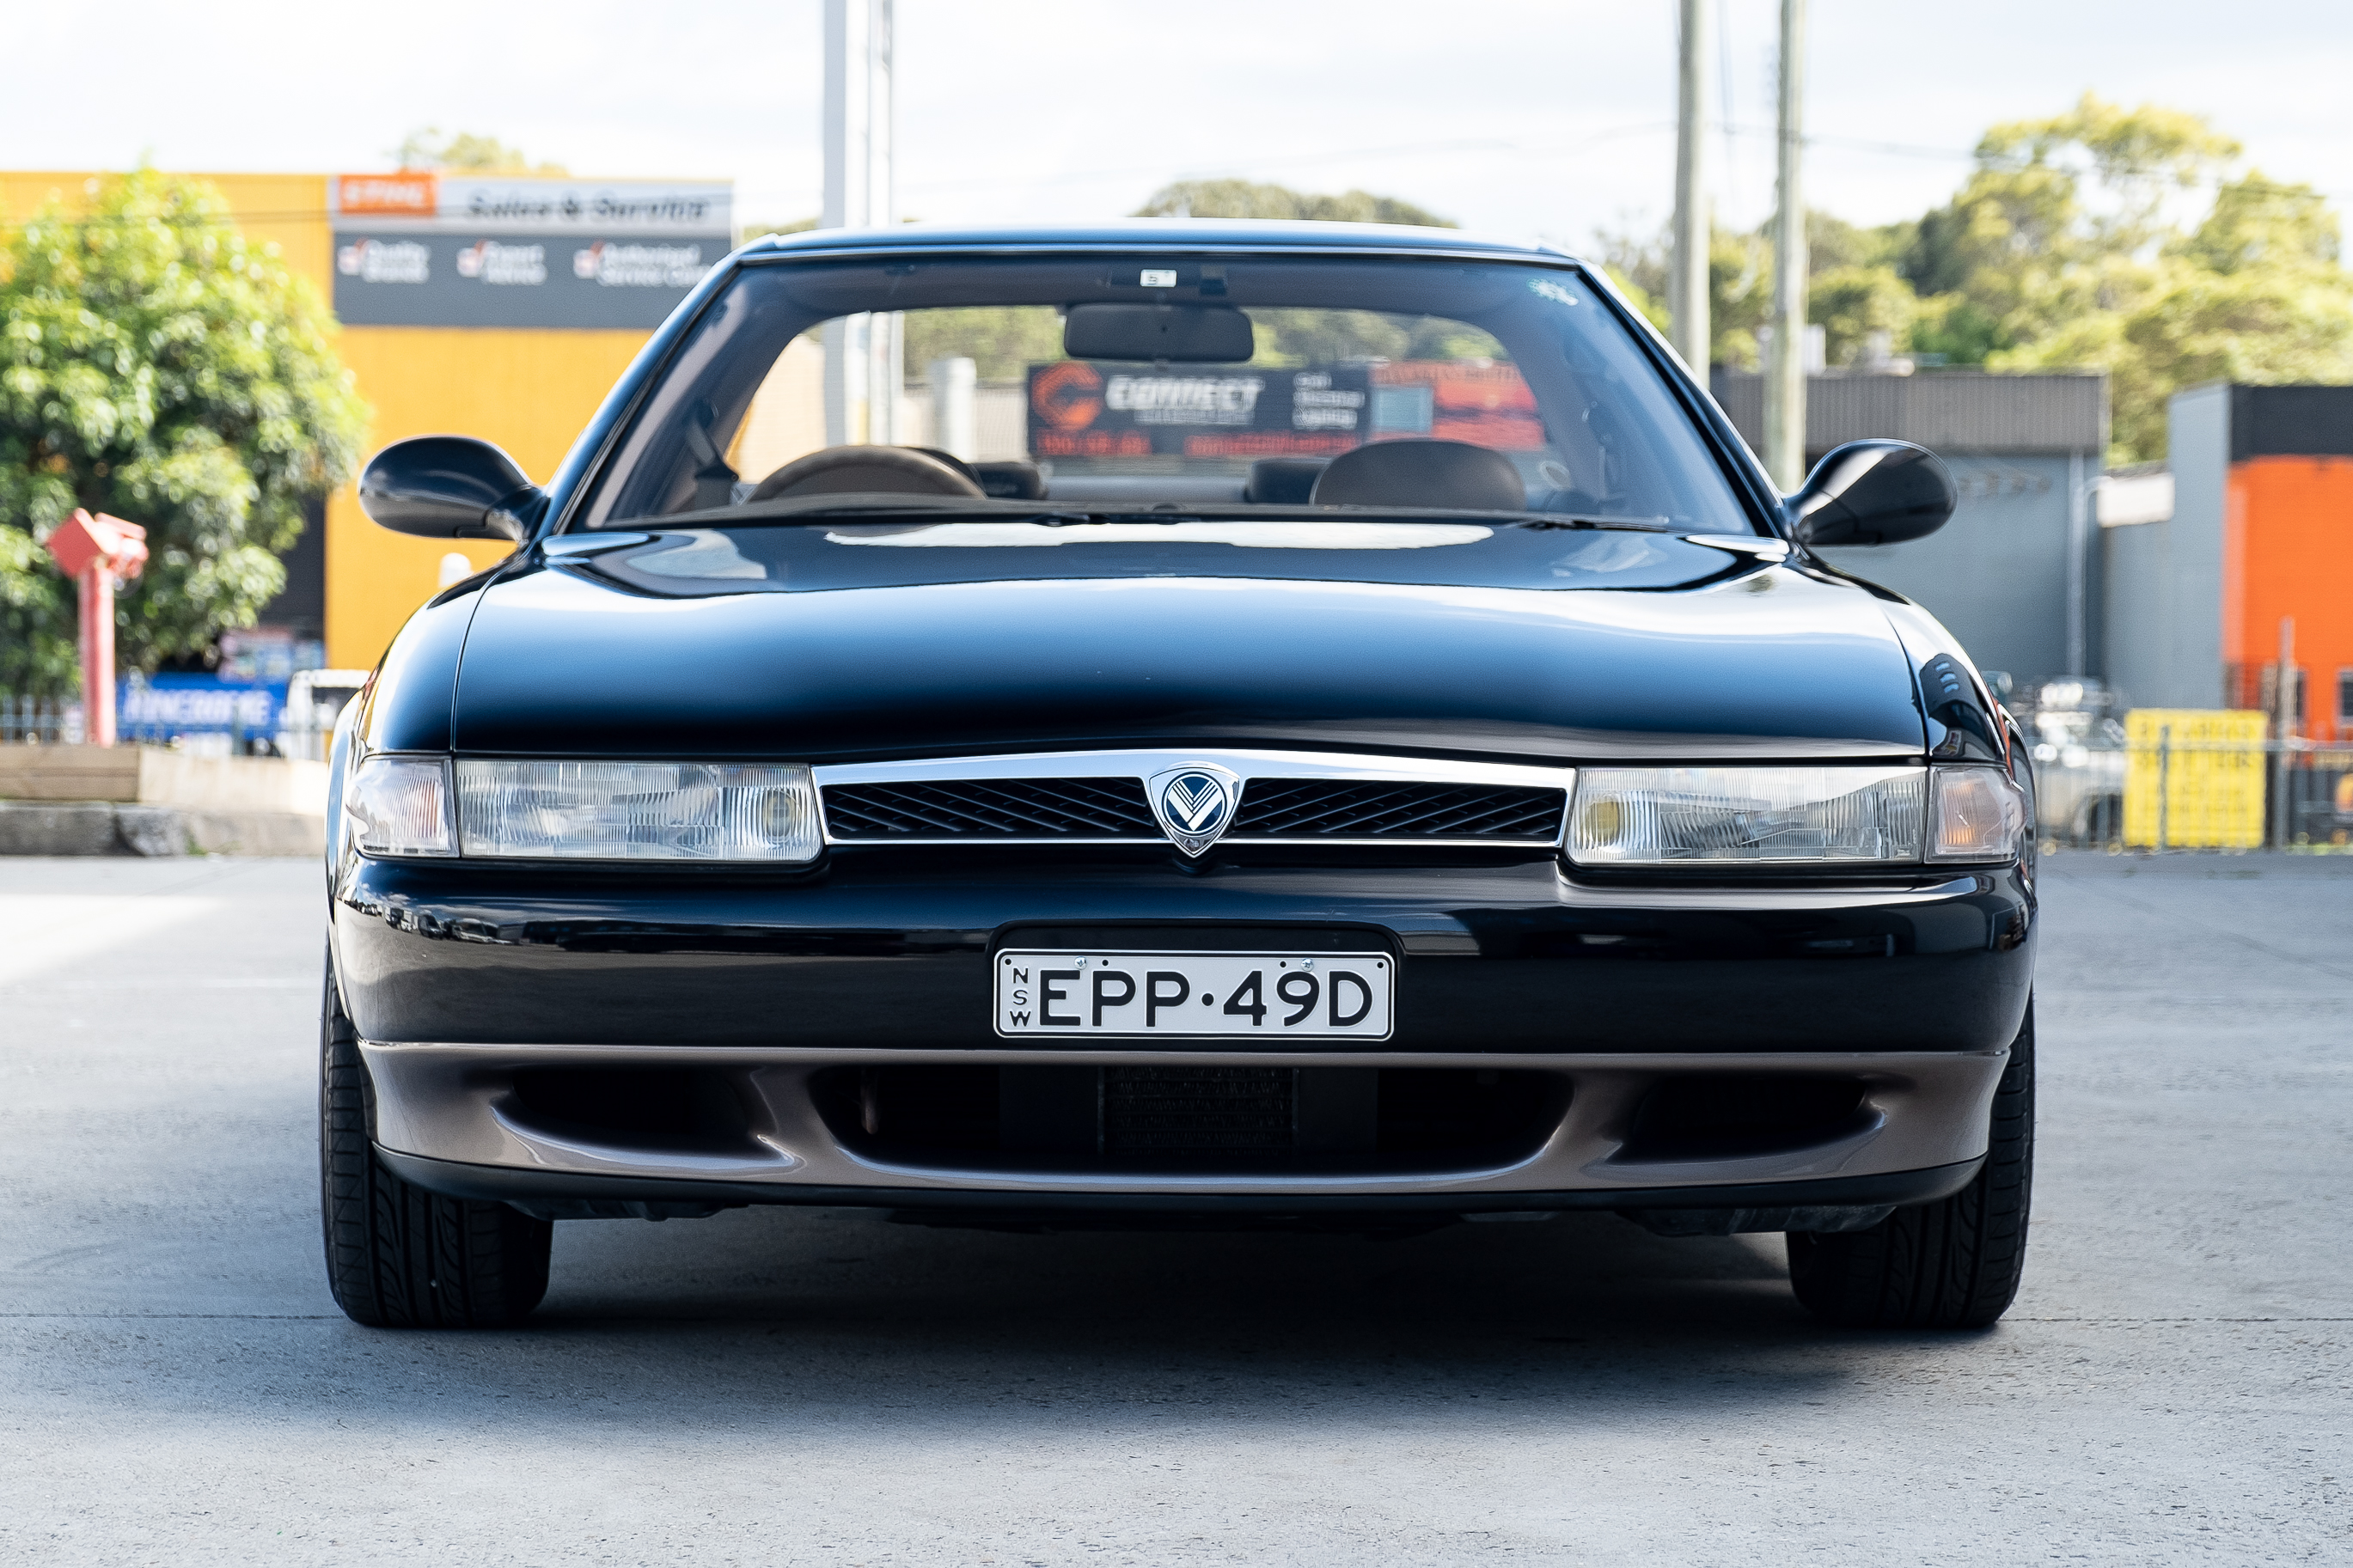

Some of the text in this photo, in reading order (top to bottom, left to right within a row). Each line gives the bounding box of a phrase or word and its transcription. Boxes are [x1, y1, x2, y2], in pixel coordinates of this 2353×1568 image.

[469, 190, 707, 221] Sales & Service
